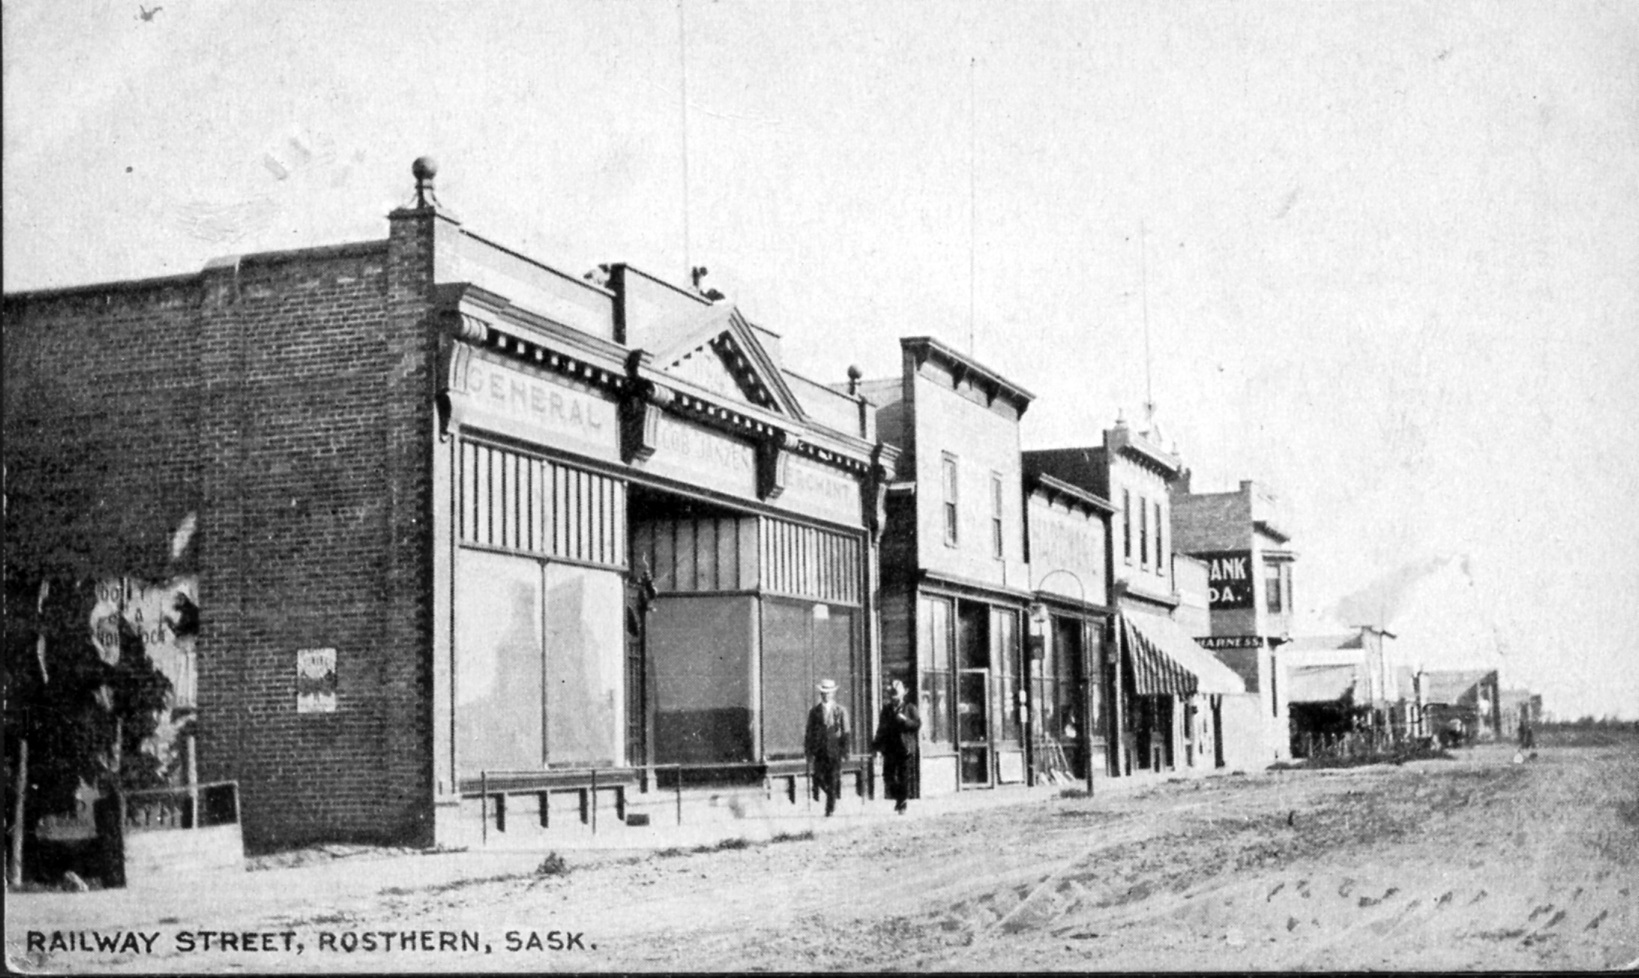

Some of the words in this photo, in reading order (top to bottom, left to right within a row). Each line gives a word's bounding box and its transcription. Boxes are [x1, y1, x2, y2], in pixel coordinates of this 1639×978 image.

[468, 365, 602, 429] GENERAL
[1210, 557, 1247, 581] ANK
[1209, 586, 1242, 602] DA.
